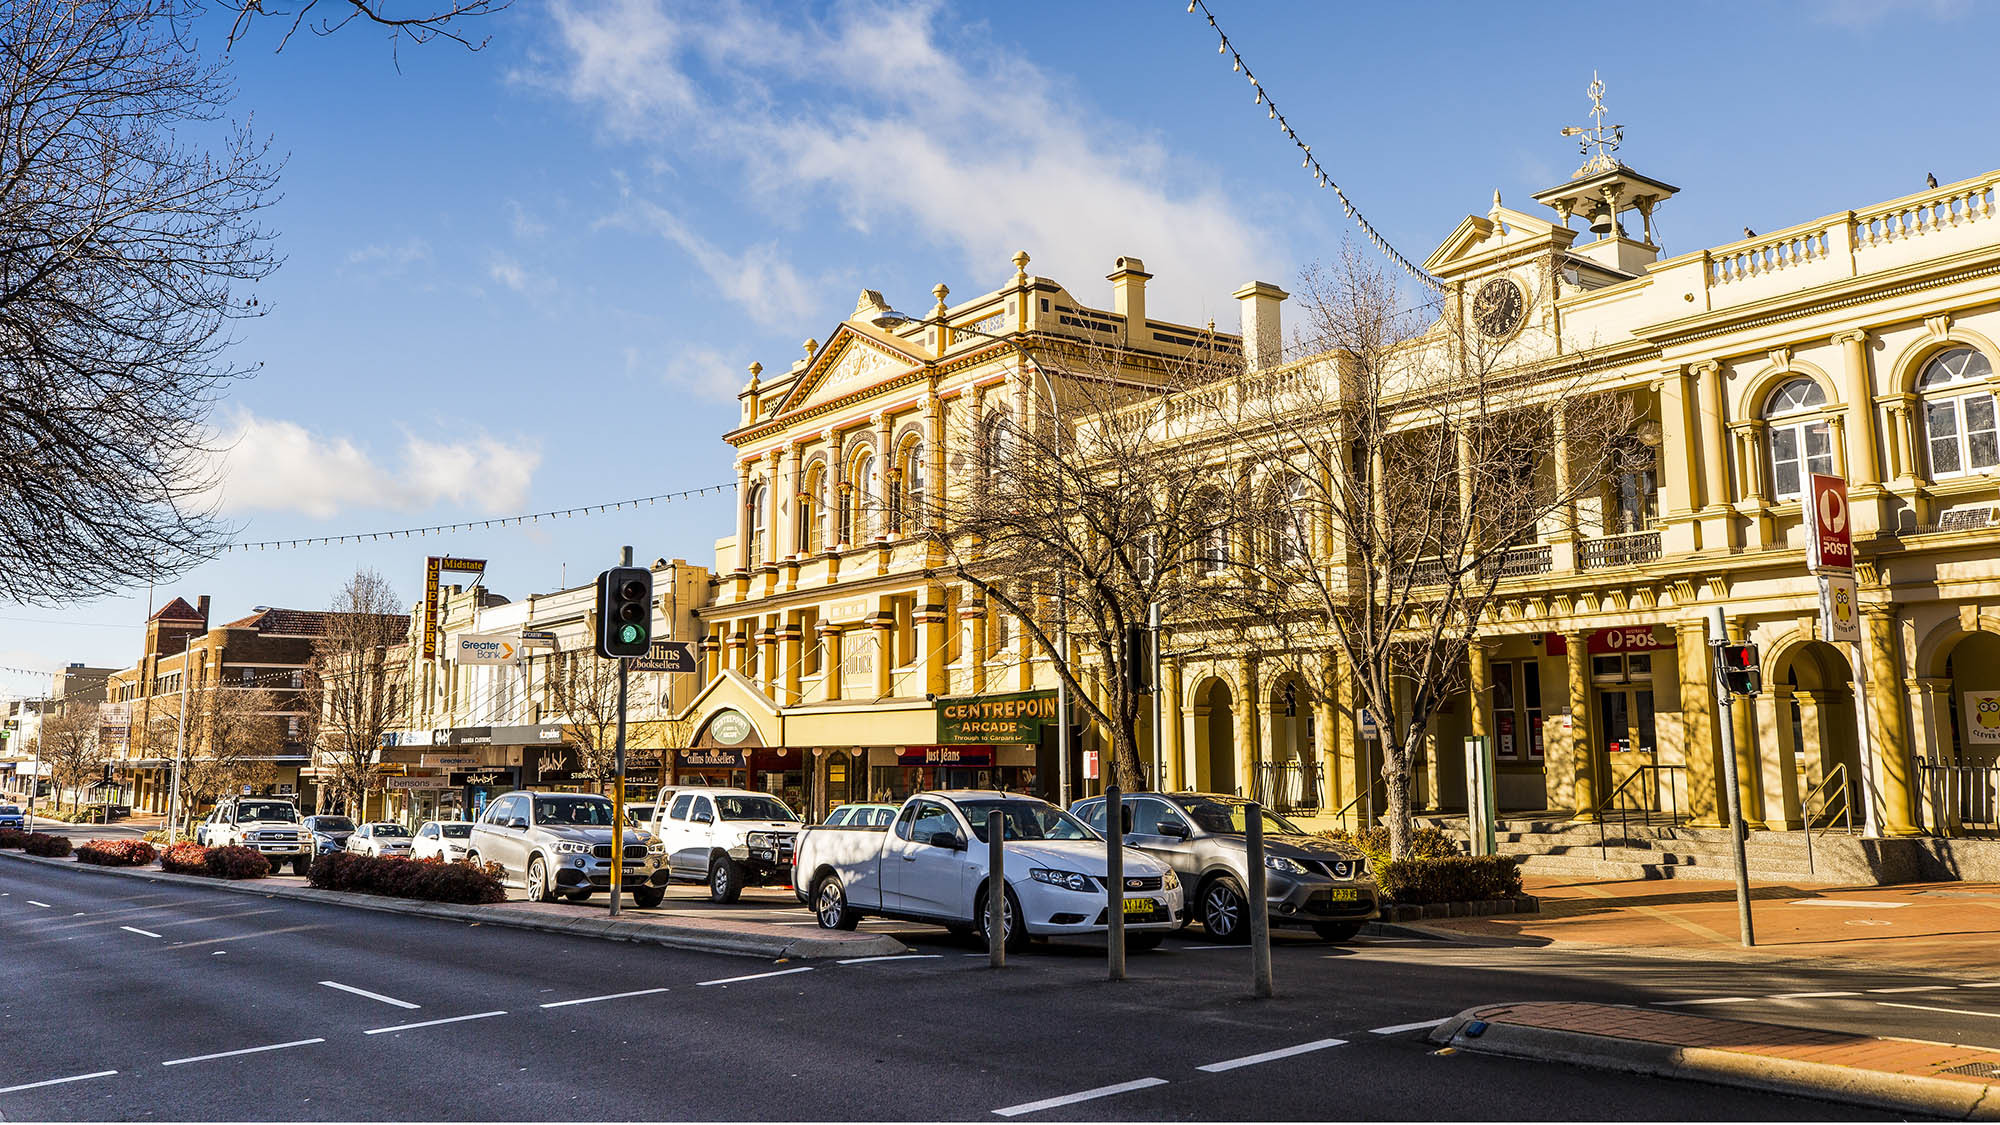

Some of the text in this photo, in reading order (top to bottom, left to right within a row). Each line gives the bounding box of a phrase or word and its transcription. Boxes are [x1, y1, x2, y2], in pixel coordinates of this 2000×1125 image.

[1510, 289, 1515, 298] 2
[1514, 299, 1518, 307] 3
[1505, 318, 1510, 327] 5
[1823, 541, 1848, 555] POST
[444, 559, 483, 570] Midstate
[424, 560, 439, 653] JEWELLERS
[462, 640, 500, 650] Greater
[1625, 633, 1657, 648] POS
[477, 649, 501, 659] Bank
[640, 645, 680, 660] ollins
[636, 659, 680, 669] booksellers
[961, 722, 1017, 733] ARCADE
[1973, 729, 1996, 739] CLEVER
[687, 752, 735, 764] collins booksellers
[926, 748, 939, 763] Just
[393, 779, 430, 787] bensons
